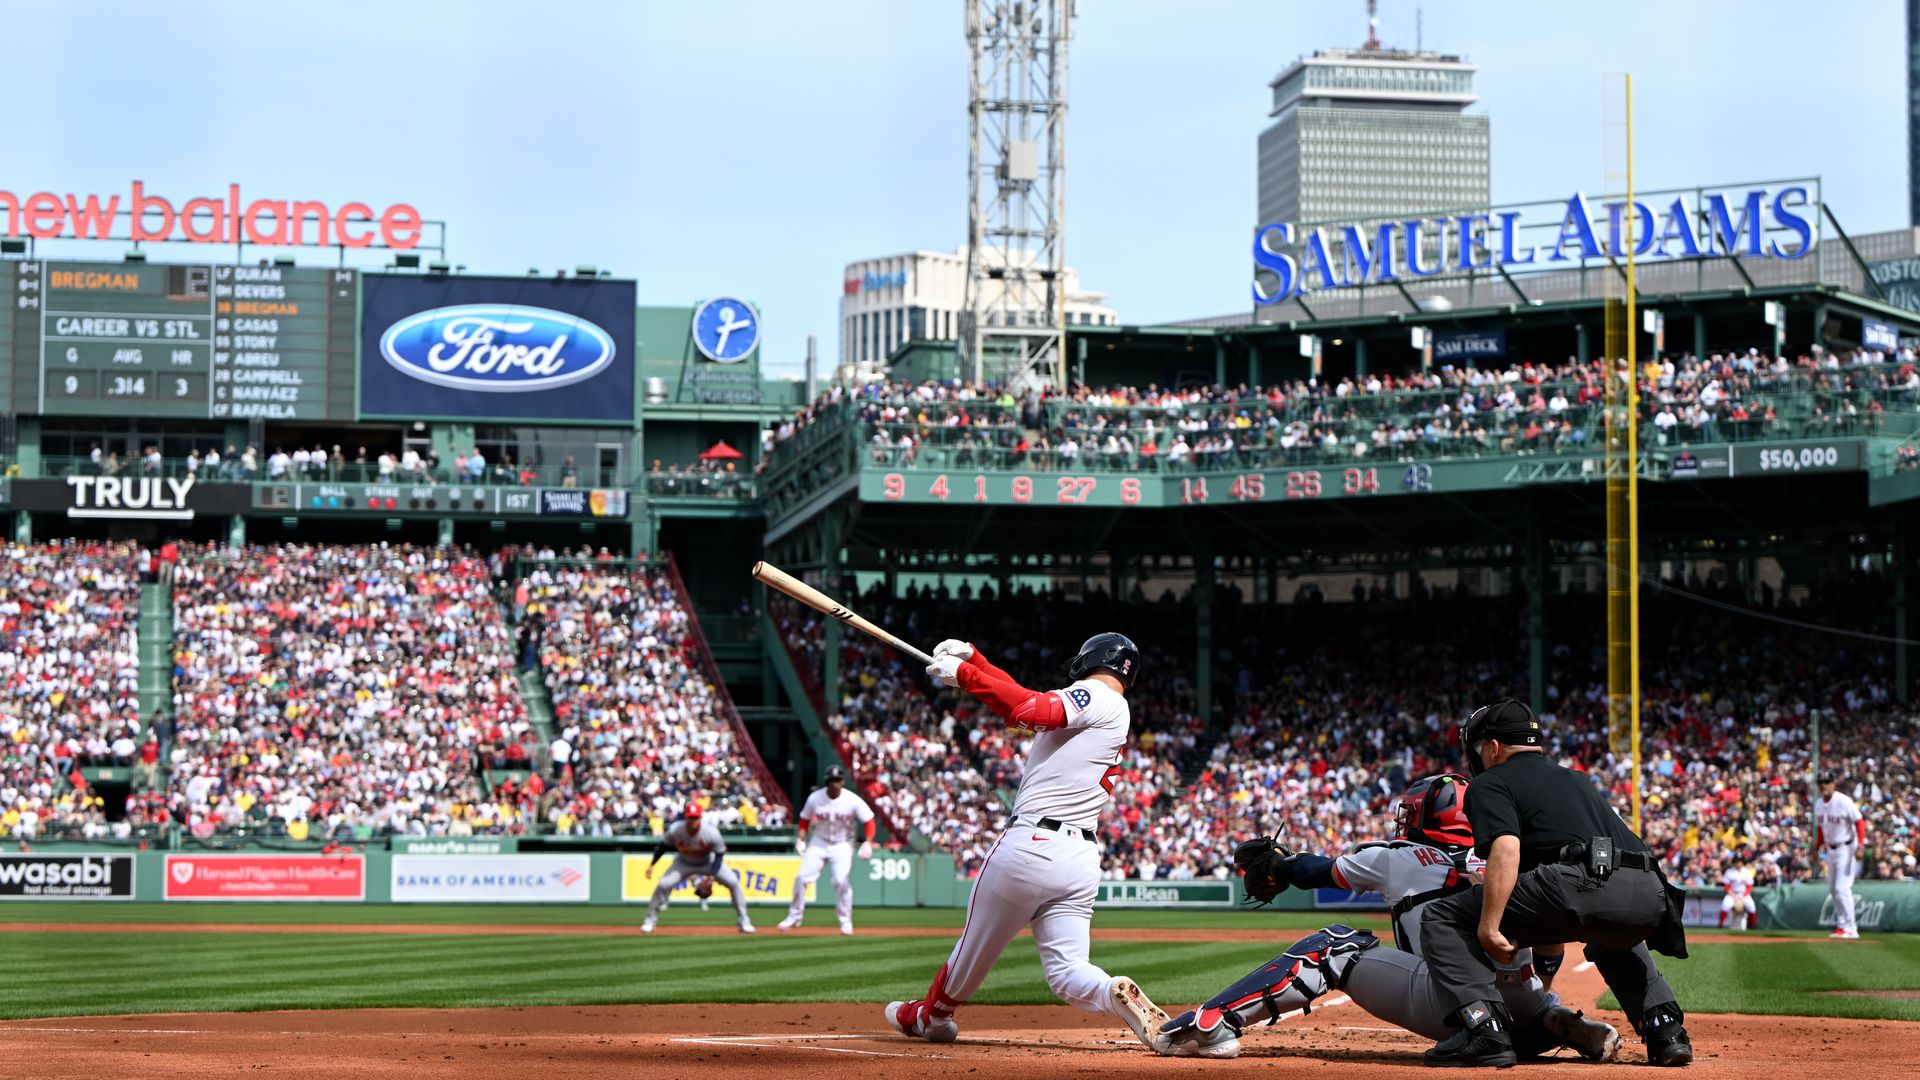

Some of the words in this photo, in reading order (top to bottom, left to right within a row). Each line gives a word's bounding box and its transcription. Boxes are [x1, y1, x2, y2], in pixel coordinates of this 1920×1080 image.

[0, 189, 120, 239] new
[132, 180, 422, 250] balance
[1251, 210, 1541, 306] SAMUEL
[1548, 186, 1819, 261] ADAMS
[51, 271, 139, 289] BREGMAN
[234, 268, 282, 282] DURAN
[234, 284, 286, 299] DEVERS
[234, 302, 298, 316] BREGMAN
[56, 317, 130, 337] CAREER
[134, 319, 160, 338] VS
[164, 320, 200, 339] STL
[233, 318, 279, 333] CASAS
[233, 335, 277, 350] STORY
[427, 316, 569, 376] Ford
[1436, 341, 1462, 357] SAM
[1464, 338, 1499, 353] DECK
[66, 347, 79, 364] G
[112, 348, 144, 365] AVG
[171, 349, 193, 365] HR
[233, 352, 280, 367] ABREU
[65, 375, 79, 395] 9
[107, 376, 146, 396] .314
[175, 378, 189, 397] 3
[232, 370, 304, 385] CAMPBELL
[231, 403, 297, 419] RAFAELA
[1759, 446, 1838, 471] $50,000
[319, 486, 347, 496] BALL
[364, 486, 400, 497] STRIKE
[411, 487, 434, 498] OUT
[884, 473, 905, 500] 9
[930, 475, 950, 501] 4
[975, 475, 987, 501] 1
[1012, 476, 1033, 502] 8
[1056, 476, 1096, 504] 27
[1120, 478, 1142, 505] 6
[1181, 477, 1208, 503] 14
[1229, 474, 1264, 500] 45
[1285, 471, 1322, 498] 26
[1342, 467, 1379, 494] 34
[1401, 463, 1432, 491] 42
[66, 476, 195, 509] TRULY
[0, 855, 112, 885] wasabi
[196, 866, 245, 879] Harvard
[245, 866, 287, 881] Pilgrim
[869, 858, 911, 881] 380
[397, 874, 442, 886] BANK
[447, 874, 466, 886] OF
[471, 874, 546, 886] AMERICA
[745, 870, 778, 895] TEA
[24, 884, 41, 894] hot
[43, 884, 71, 894] cloud
[73, 885, 112, 896] storage
